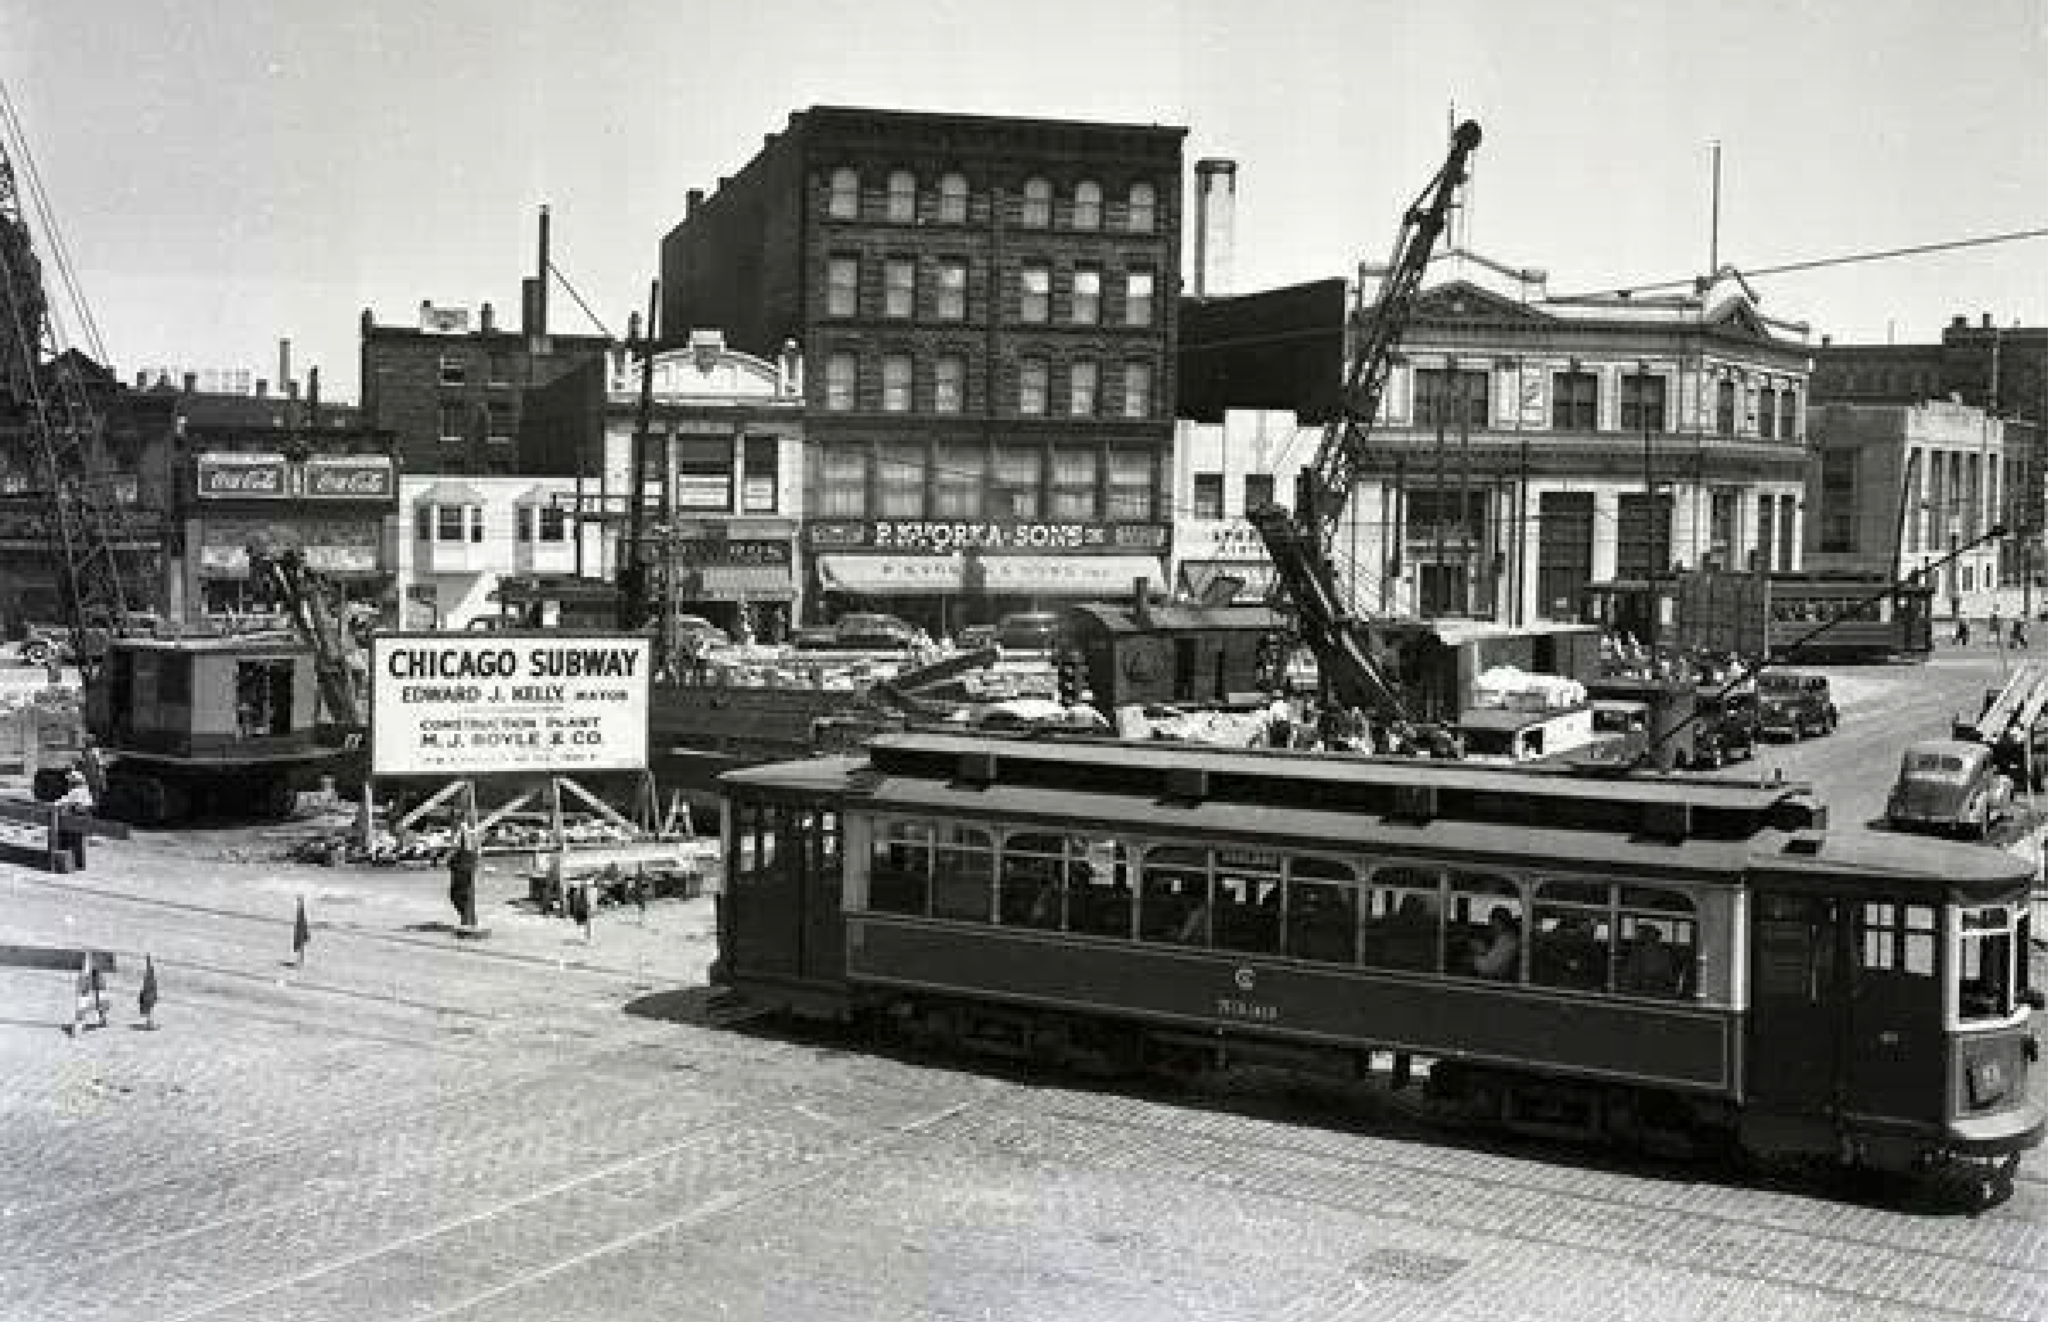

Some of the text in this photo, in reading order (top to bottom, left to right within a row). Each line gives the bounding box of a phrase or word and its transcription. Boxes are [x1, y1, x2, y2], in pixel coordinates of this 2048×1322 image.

[1013, 523, 1083, 547] SONS
[388, 648, 639, 679] CHICAGO SUBWAY
[402, 685, 483, 703] EDWARD
[487, 685, 503, 703] J.
[511, 685, 564, 702] KELLY
[419, 716, 602, 731] CONSTRUCTION PLANT
[419, 733, 441, 748] M.
[447, 733, 465, 748] J.
